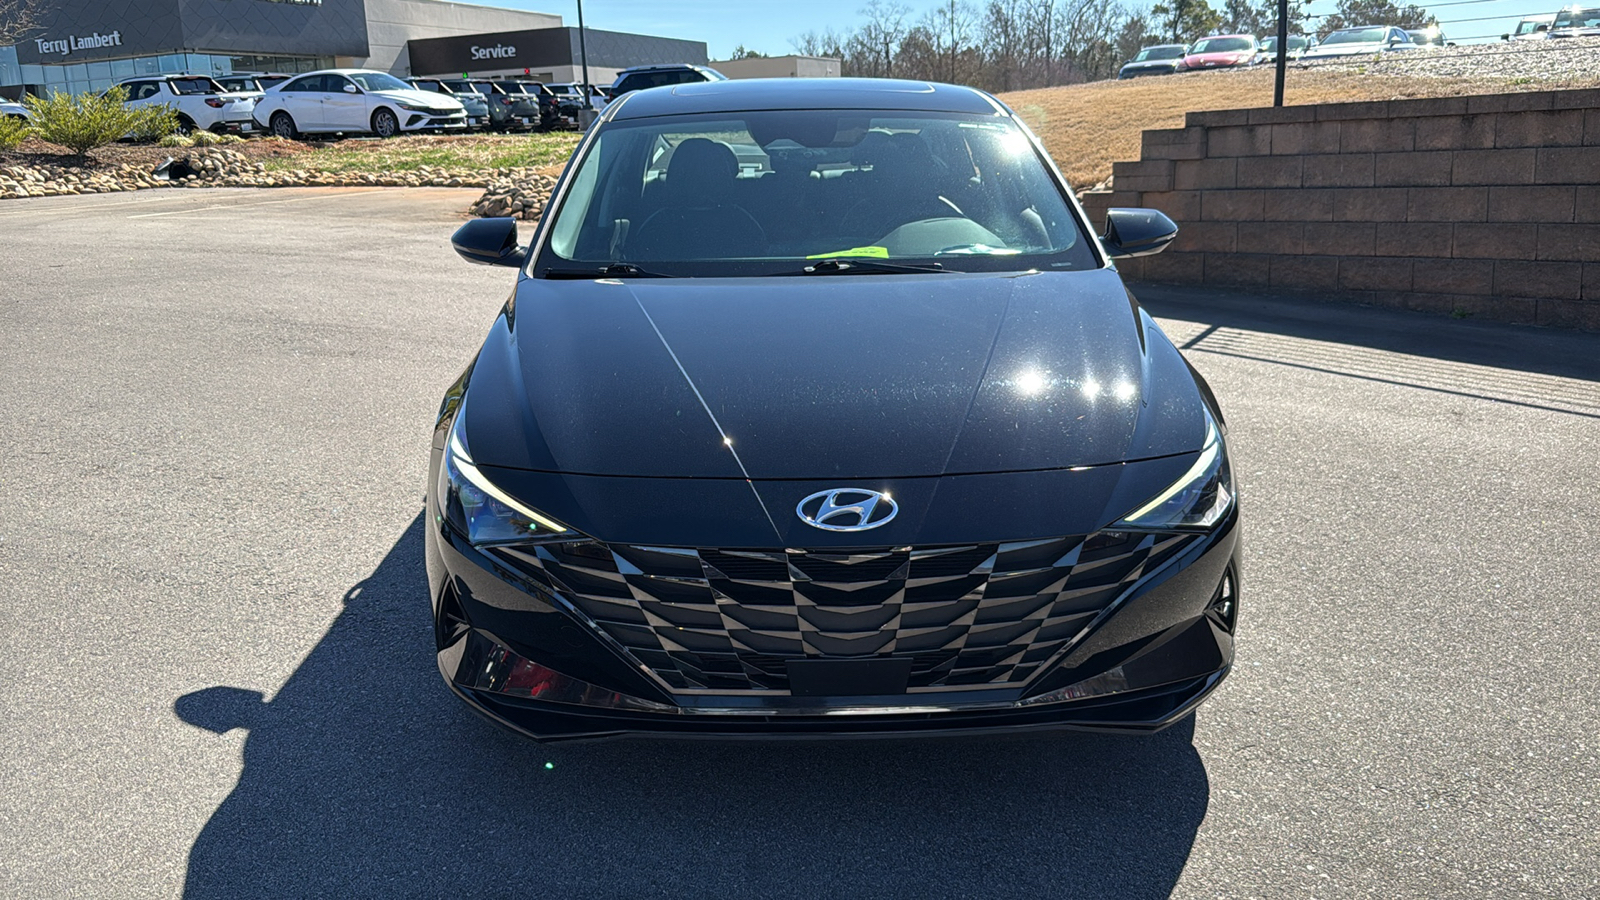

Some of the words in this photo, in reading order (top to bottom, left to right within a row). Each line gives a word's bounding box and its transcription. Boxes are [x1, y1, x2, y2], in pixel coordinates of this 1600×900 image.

[34, 38, 70, 55] Terry
[69, 30, 122, 50] Lambert
[470, 43, 517, 60] Service
